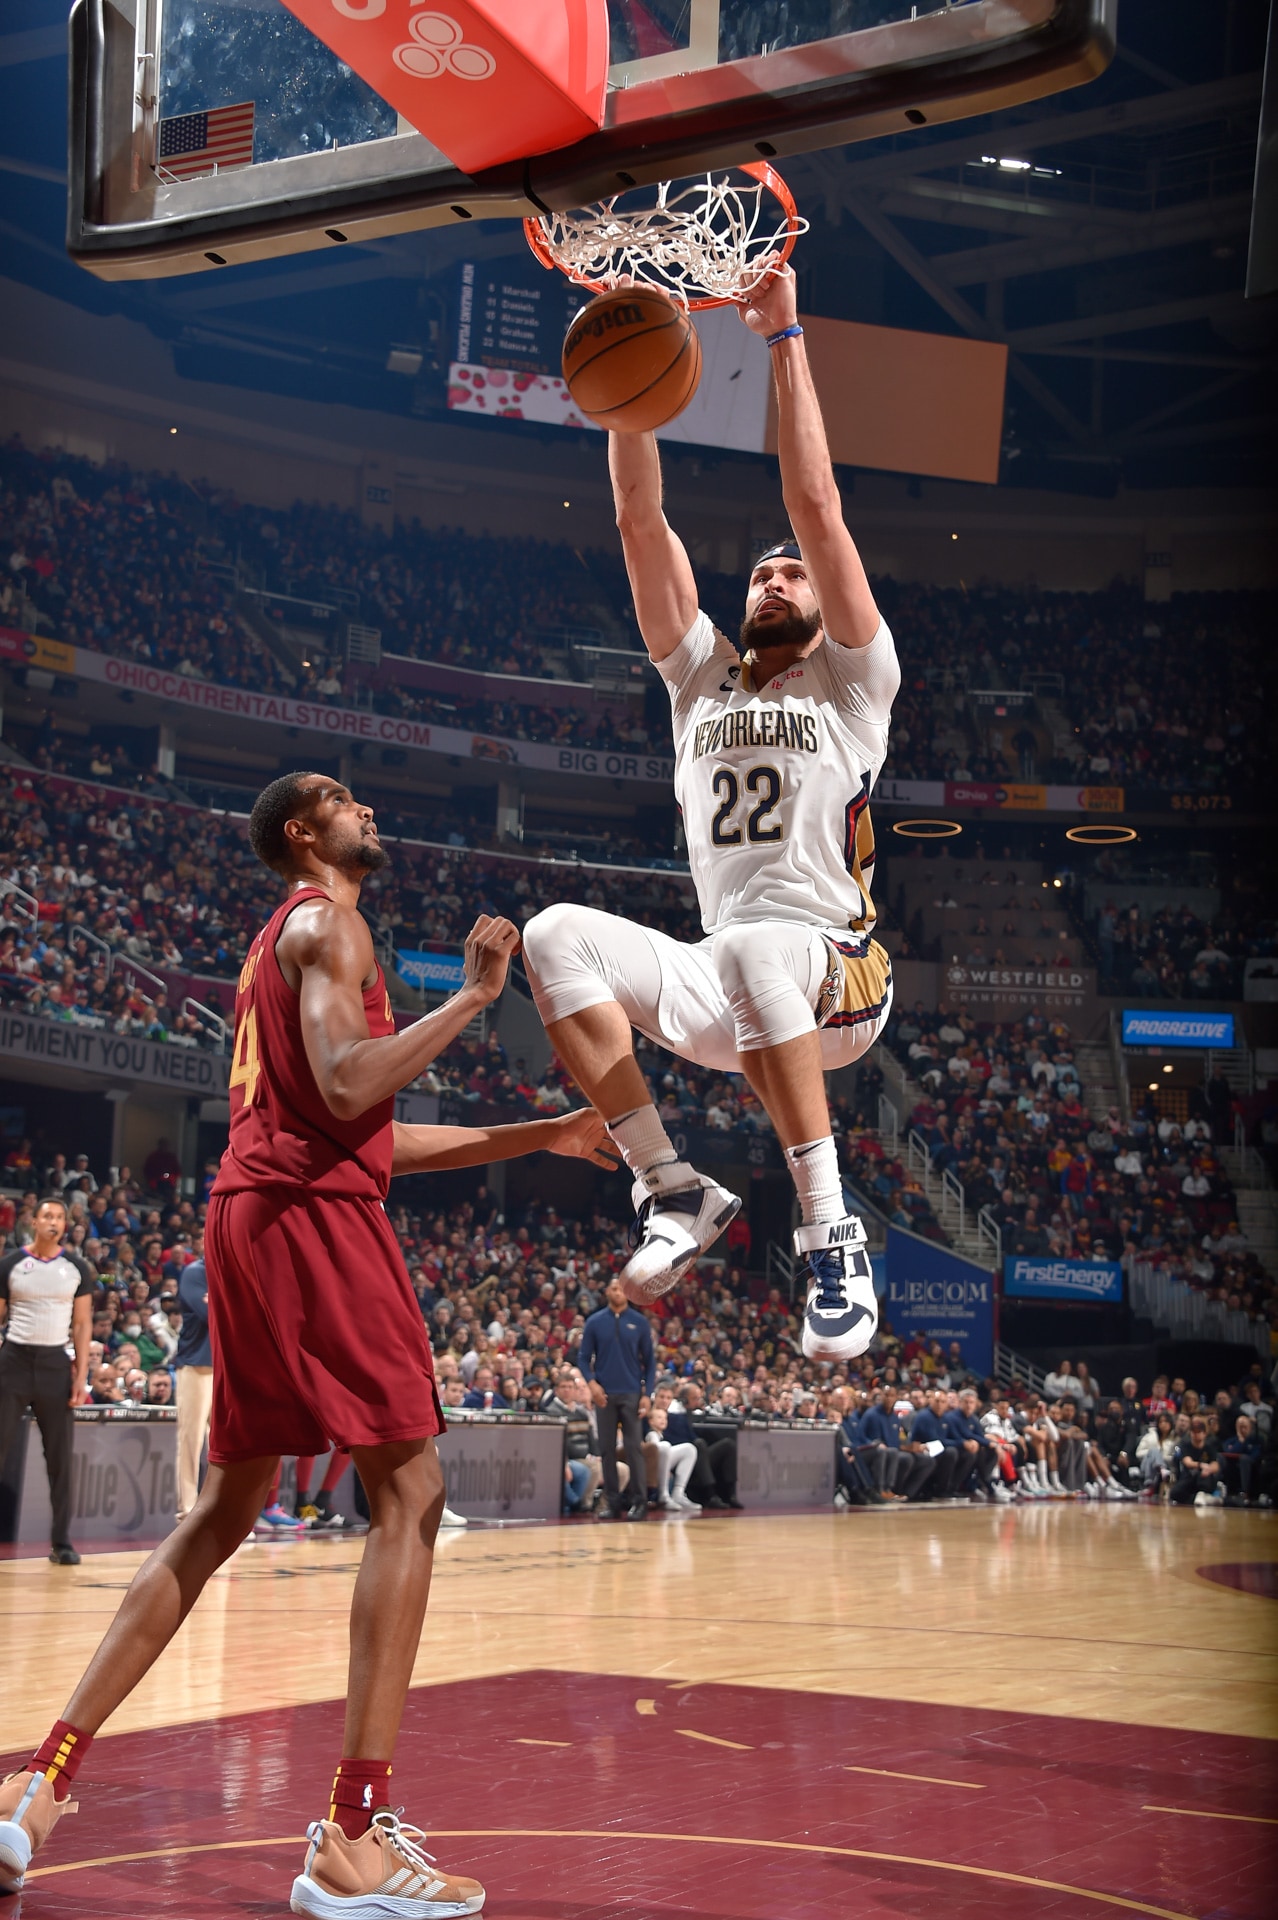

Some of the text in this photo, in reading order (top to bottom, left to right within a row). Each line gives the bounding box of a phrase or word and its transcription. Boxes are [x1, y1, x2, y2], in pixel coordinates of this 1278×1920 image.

[502, 285, 541, 299] Marshall
[457, 263, 475, 362] NEW ORLEANS PELICANS
[501, 299, 535, 313] Daniels
[501, 313, 540, 327] Alvarado
[500, 327, 535, 340] Graham
[482, 337, 494, 348] 22
[499, 340, 527, 352] Nance
[104, 659, 432, 746] OHIOCATRENTALSTORE.COM
[692, 710, 818, 763] NEW ORLEANS
[559, 750, 598, 772] BIG
[605, 756, 638, 777] OR
[711, 764, 784, 847] 22
[1170, 795, 1233, 811] $5,073
[970, 970, 1083, 988] WESTFIELD
[950, 991, 1083, 1007] CHAMPIONS CLUB
[1125, 1019, 1228, 1038] PROGRESSIVE
[97, 1037, 147, 1073] YOU
[153, 1050, 218, 1092] NEED,
[229, 1004, 262, 1107] 4
[828, 1222, 857, 1244] NIKE
[1014, 1261, 1116, 1290] FirstEnergy
